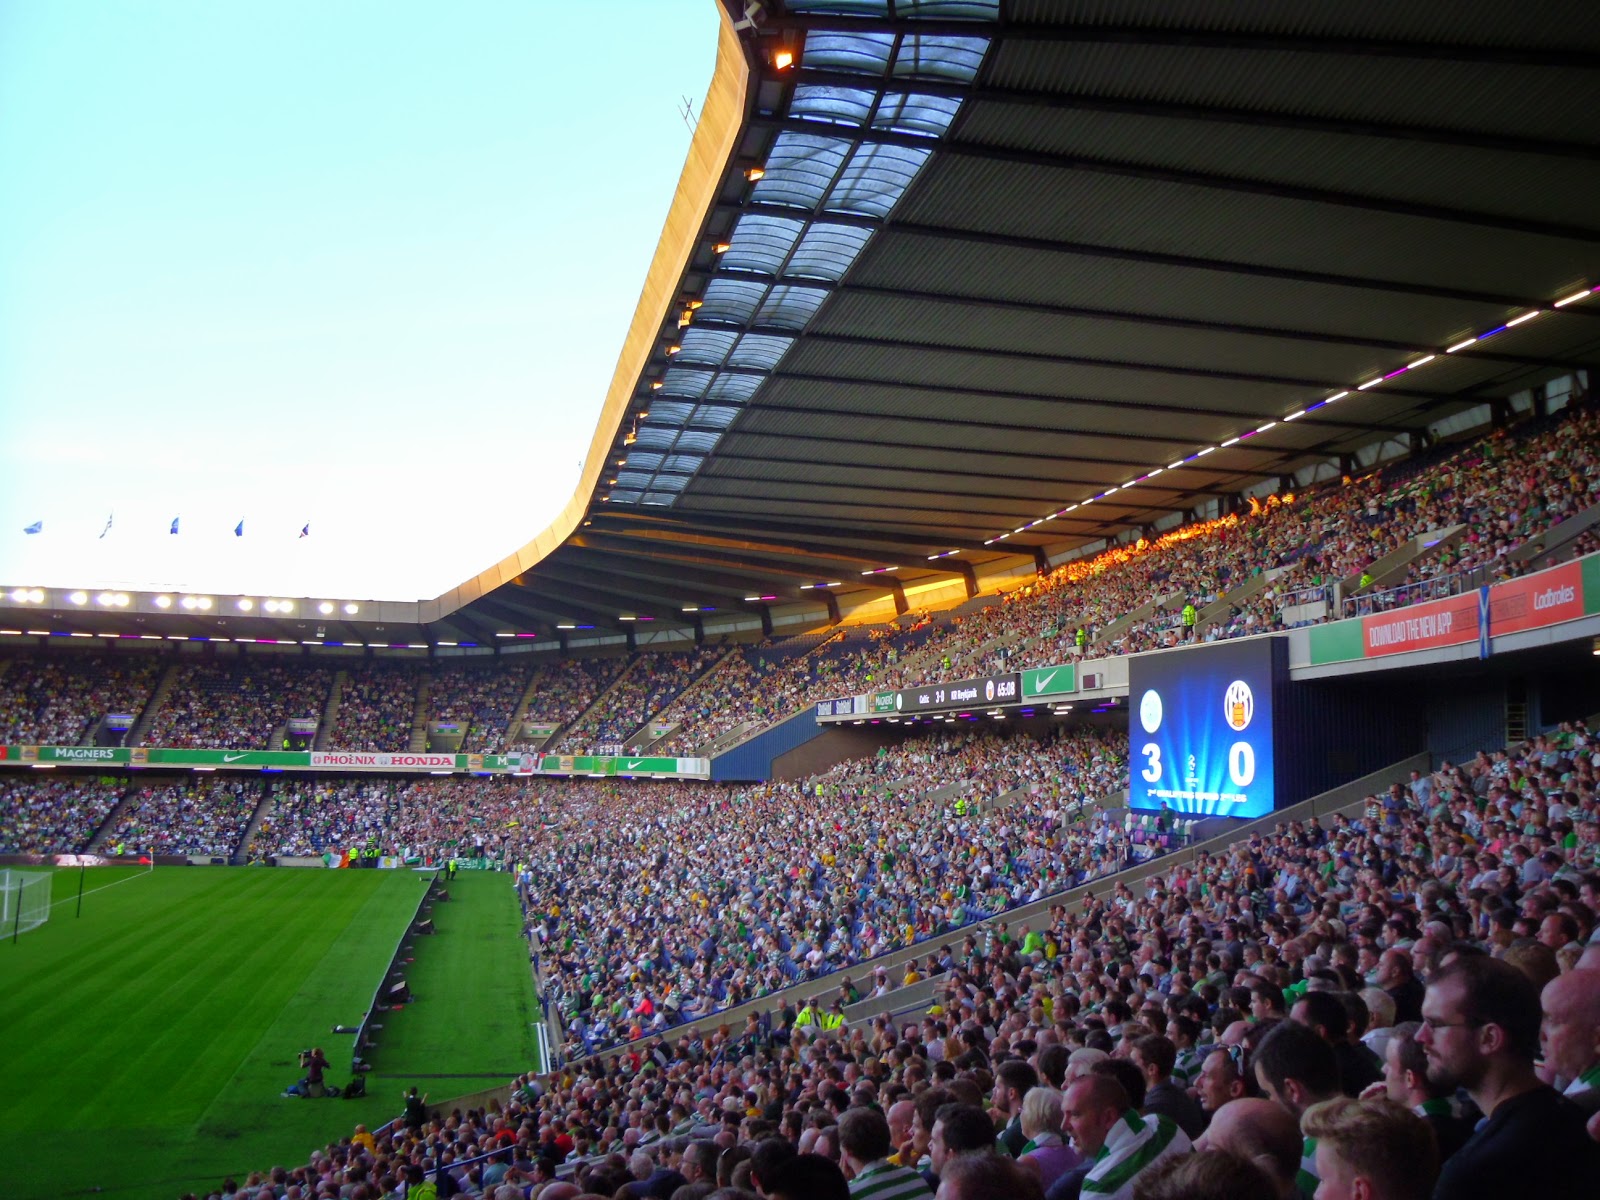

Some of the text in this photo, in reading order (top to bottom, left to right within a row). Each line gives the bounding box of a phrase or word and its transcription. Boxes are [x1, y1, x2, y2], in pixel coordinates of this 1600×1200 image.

[1534, 585, 1574, 610] Ladbrokes
[1370, 621, 1406, 647] DOWNLOAD
[1406, 618, 1420, 640] THE
[1420, 615, 1436, 638] NEW
[1438, 612, 1452, 635] APP
[997, 681, 1015, 697] 65:08
[55, 748, 114, 758] MAGNERS
[323, 755, 453, 766] PHOENIX HONDA
[1142, 743, 1162, 782] 3
[1229, 741, 1255, 786] 0
